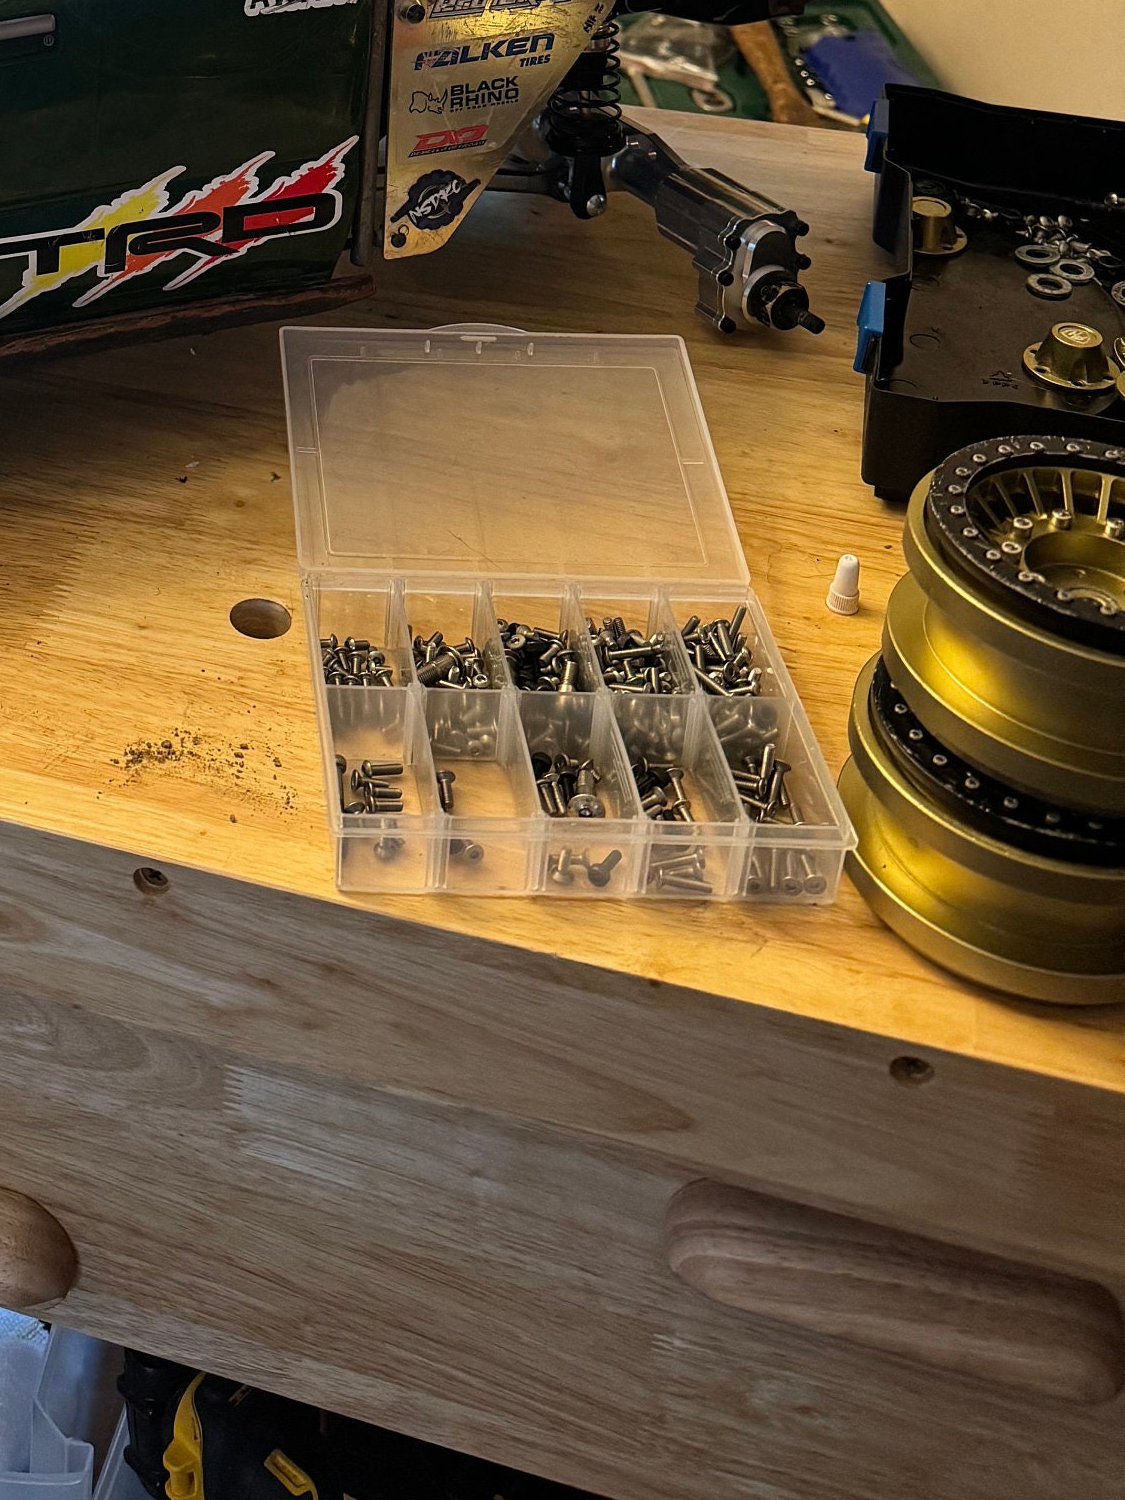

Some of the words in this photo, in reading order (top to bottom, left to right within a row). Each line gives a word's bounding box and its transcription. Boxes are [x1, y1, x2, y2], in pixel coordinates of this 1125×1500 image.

[414, 32, 555, 71] FALKEN
[519, 54, 551, 68] TIRES
[450, 75, 519, 97] BLACK
[450, 87, 519, 109] RHINO
